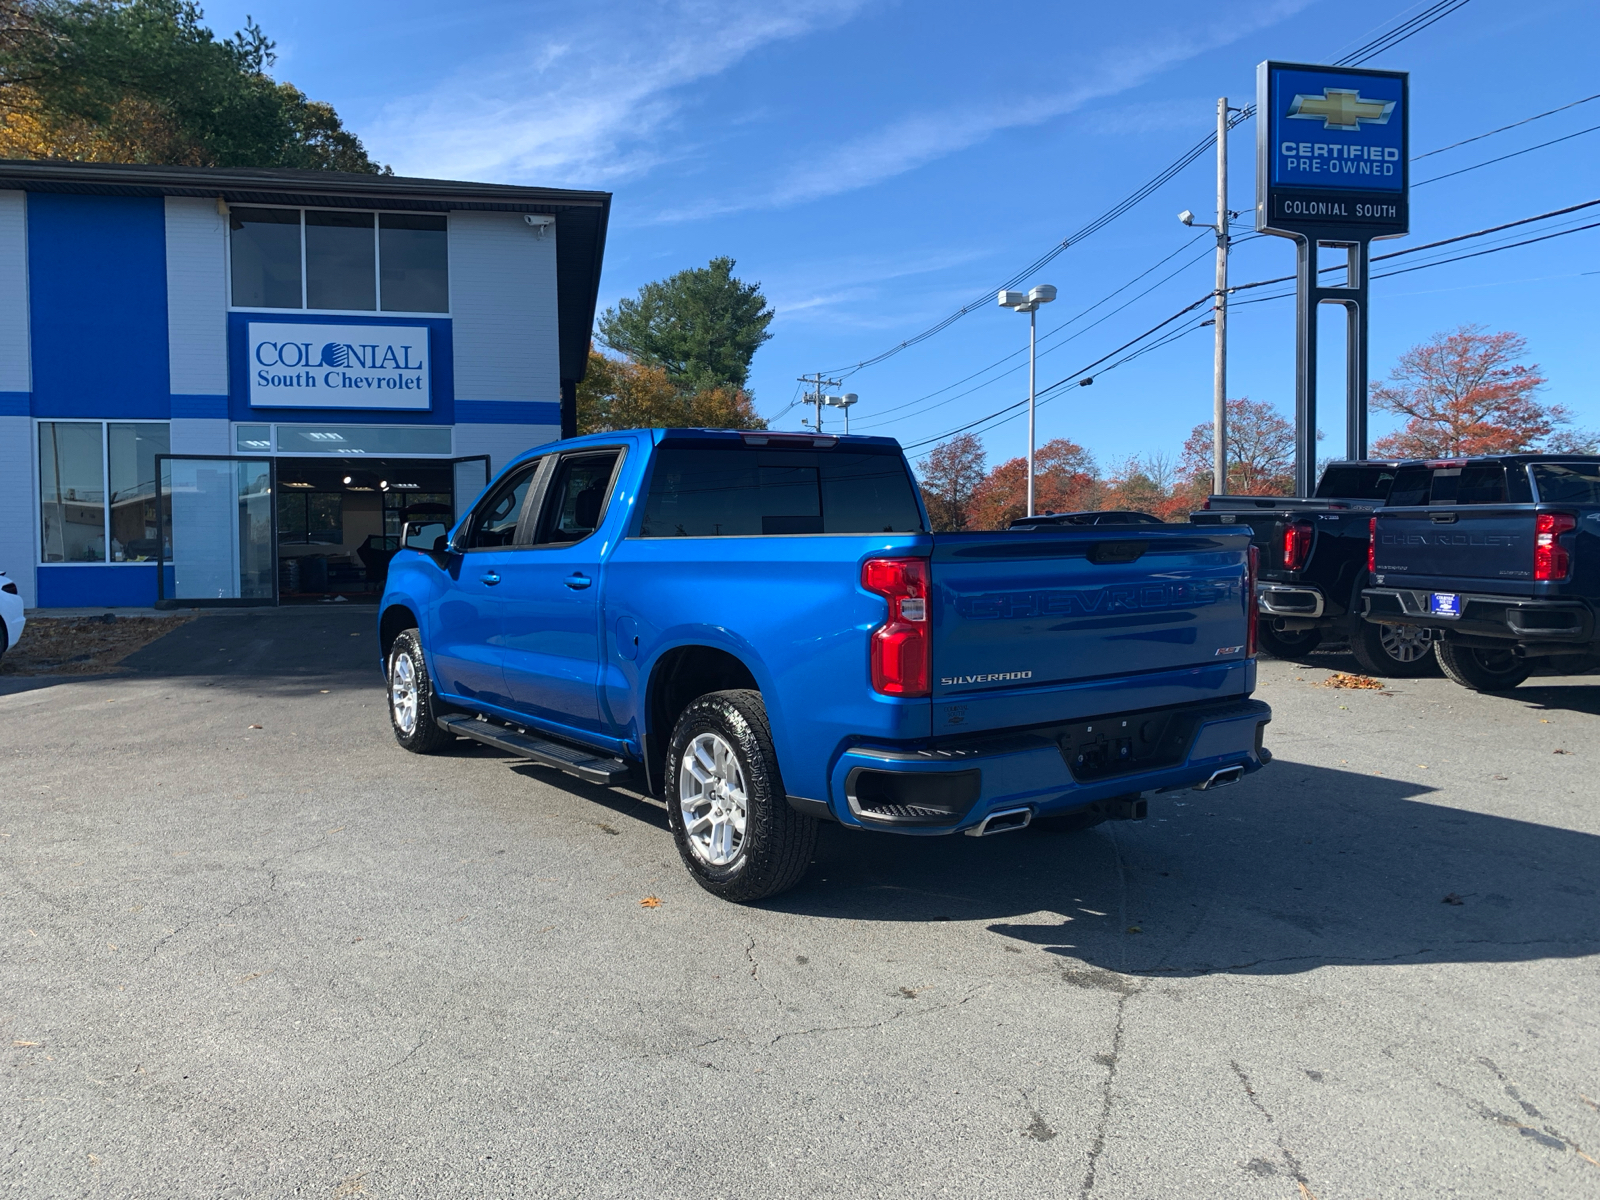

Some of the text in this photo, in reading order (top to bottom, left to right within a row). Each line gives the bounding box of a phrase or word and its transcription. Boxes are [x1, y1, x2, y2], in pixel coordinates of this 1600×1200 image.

[1281, 141, 1399, 161] CERTIFIED
[1287, 158, 1394, 176] PRE-OWNED
[1284, 200, 1396, 218] COLONIAL SOUTH
[255, 341, 423, 370] COLONIAL
[257, 369, 423, 390] South Chevrolet
[1381, 534, 1520, 546] CHEVROLET
[1214, 644, 1244, 656] RST
[941, 670, 1032, 686] SILVERADO
